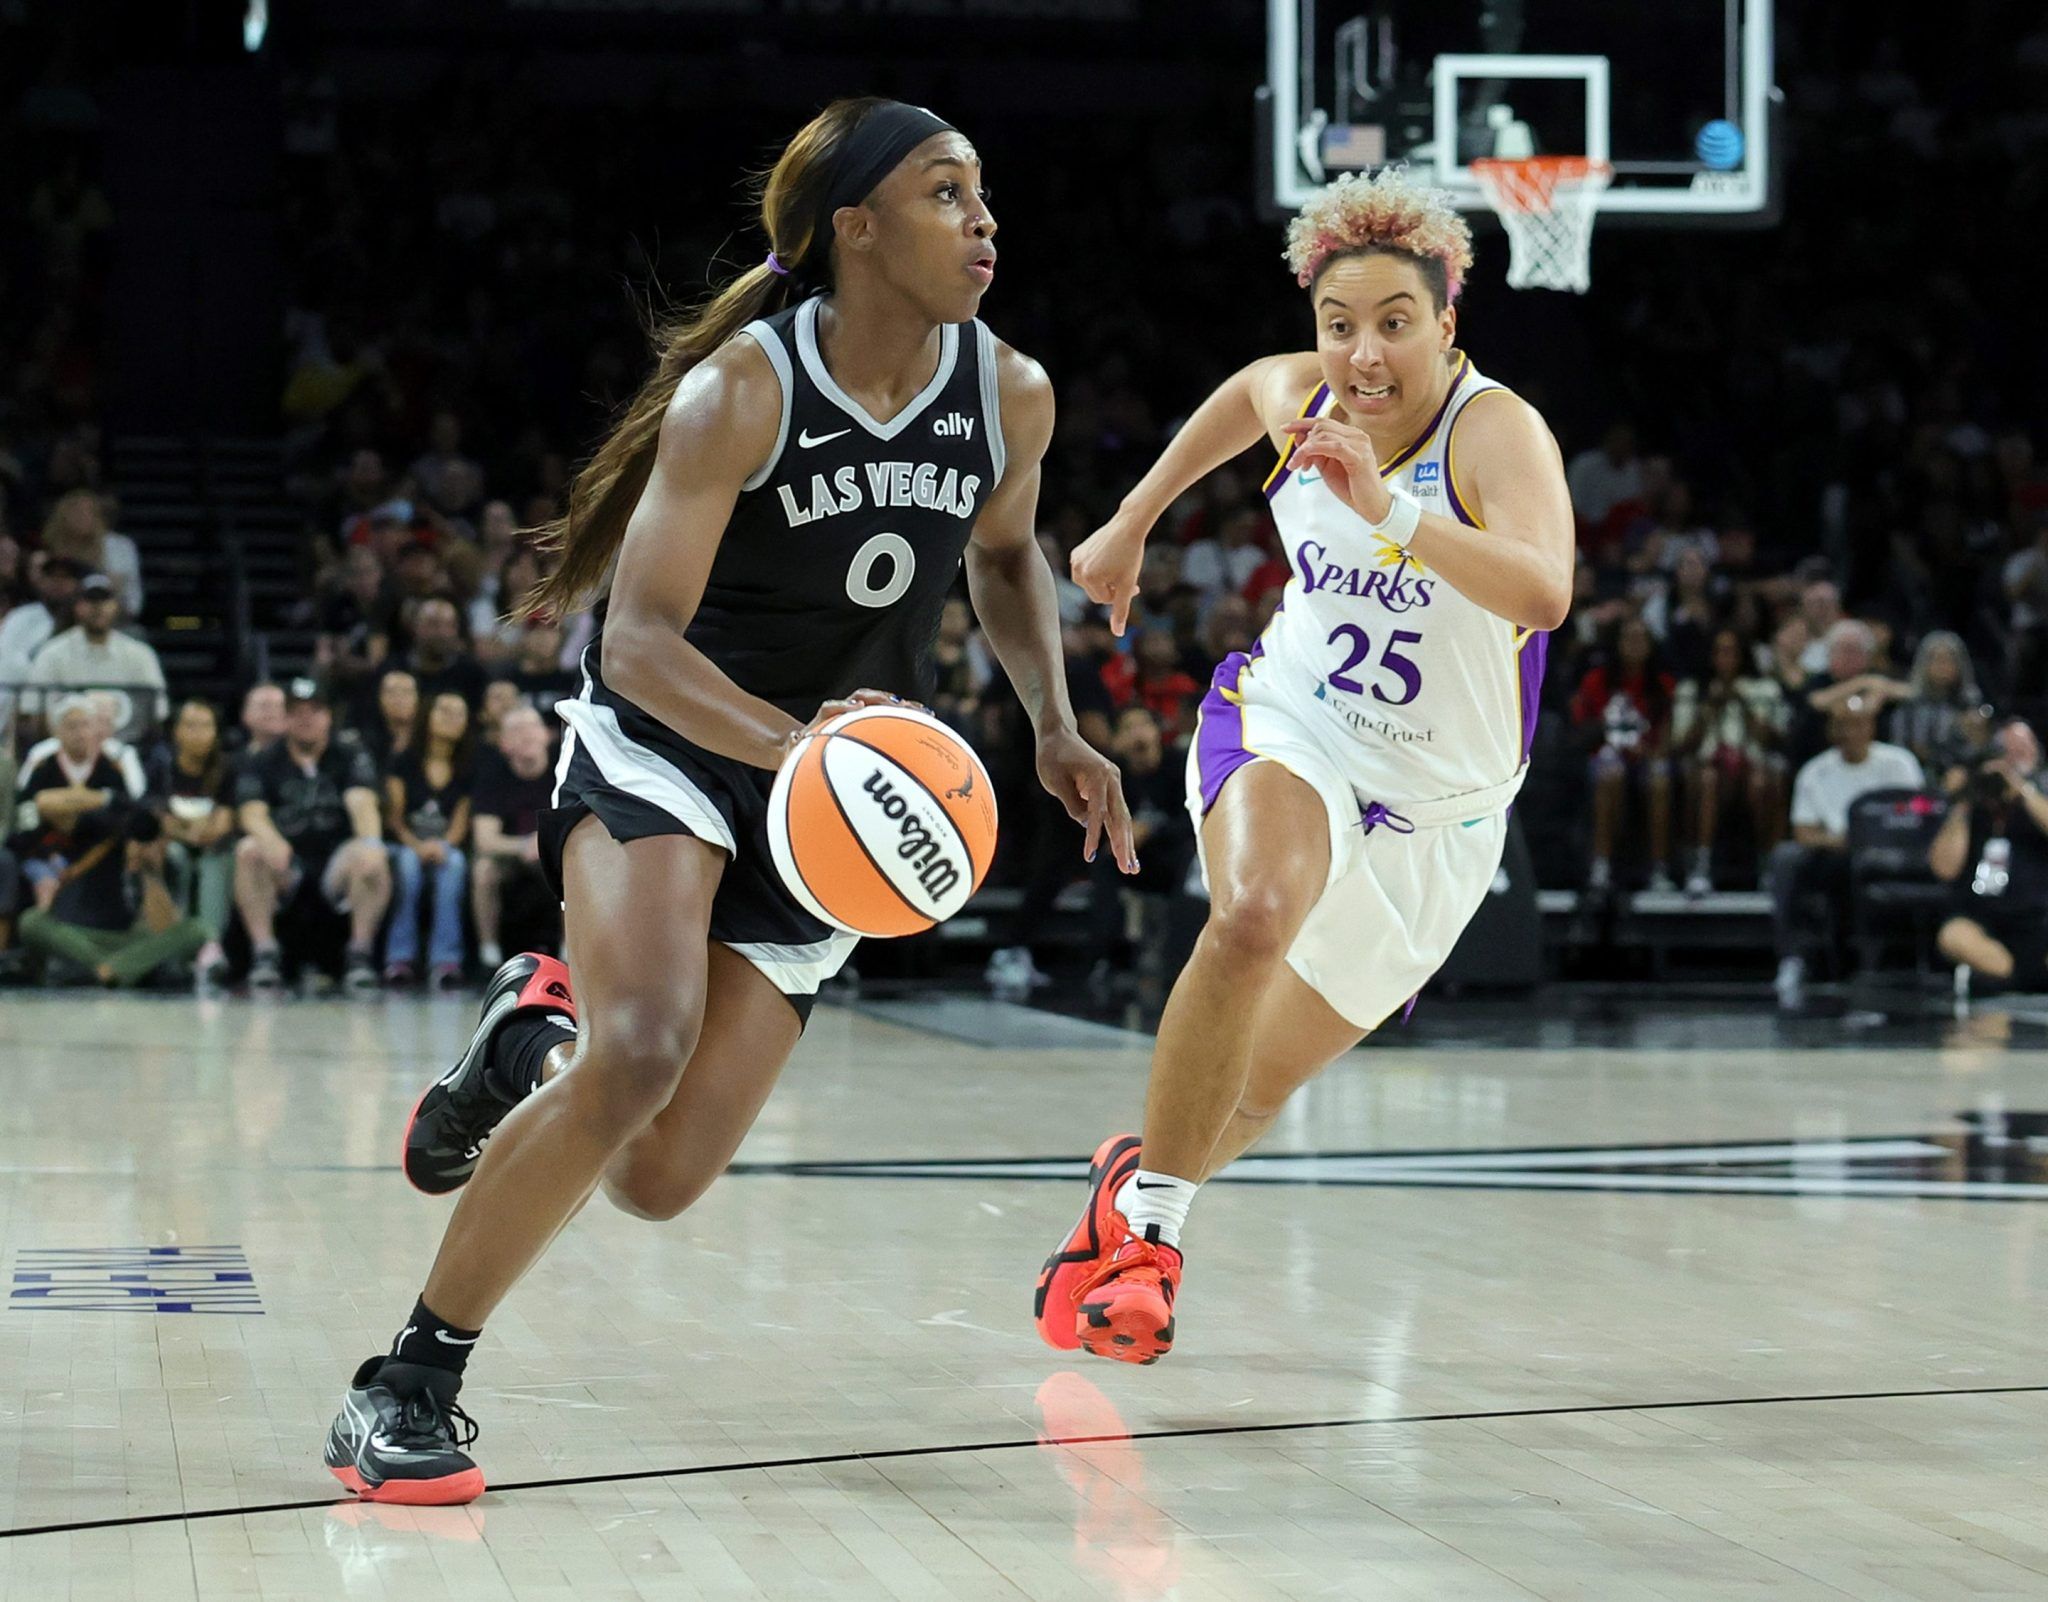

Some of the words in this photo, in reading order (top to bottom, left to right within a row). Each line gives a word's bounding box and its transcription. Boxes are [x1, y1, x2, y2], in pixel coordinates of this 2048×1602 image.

[932, 412, 975, 441] ally
[776, 466, 863, 528] LAS
[864, 461, 981, 519] VEGAS
[845, 532, 916, 608] 0
[1326, 623, 1423, 705] 25
[862, 767, 959, 904] Wilson
[8, 1244, 266, 1315] ARENA
